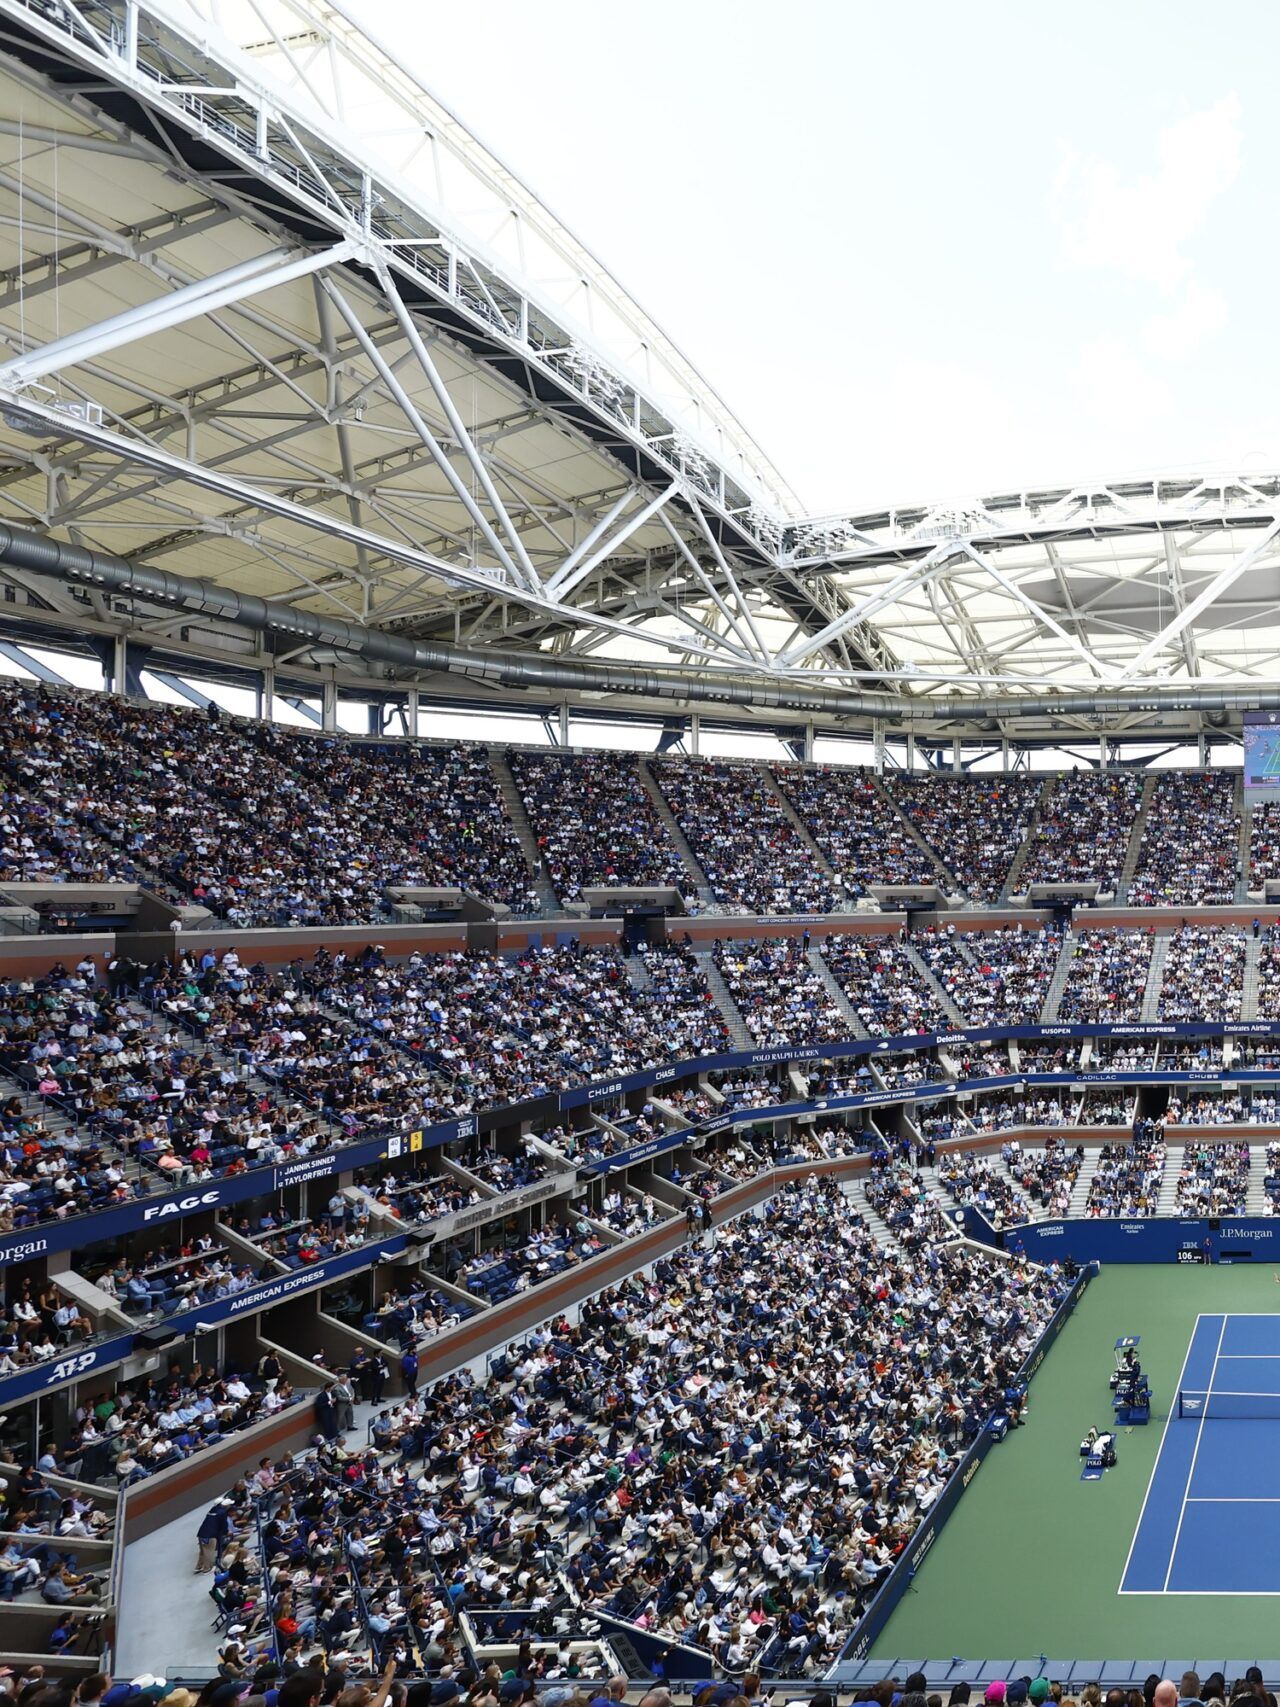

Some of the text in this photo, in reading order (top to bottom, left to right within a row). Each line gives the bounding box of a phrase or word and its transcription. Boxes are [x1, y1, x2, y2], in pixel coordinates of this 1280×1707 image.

[936, 1034, 967, 1044] Deloitte.
[752, 1049, 819, 1062] POLO RALPH LAUREN
[656, 1068, 676, 1080] CHASE
[588, 1083, 622, 1099] CHUBB
[864, 1091, 916, 1102] AMERICAN EXPRESS
[457, 1125, 474, 1138] IBM
[285, 1162, 310, 1175] JANNIK
[311, 1156, 336, 1168] SINNER
[285, 1172, 312, 1186] TAYLOR
[313, 1166, 332, 1178] FRITZ
[1220, 1228, 1273, 1240] J.P.Morgan
[1182, 1241, 1198, 1249] IBM
[1178, 1252, 1193, 1260] 106
[230, 1269, 325, 1312] AMERICAN EXPRESS
[45, 1351, 97, 1384] ATP
[850, 1634, 870, 1661] OBEL
